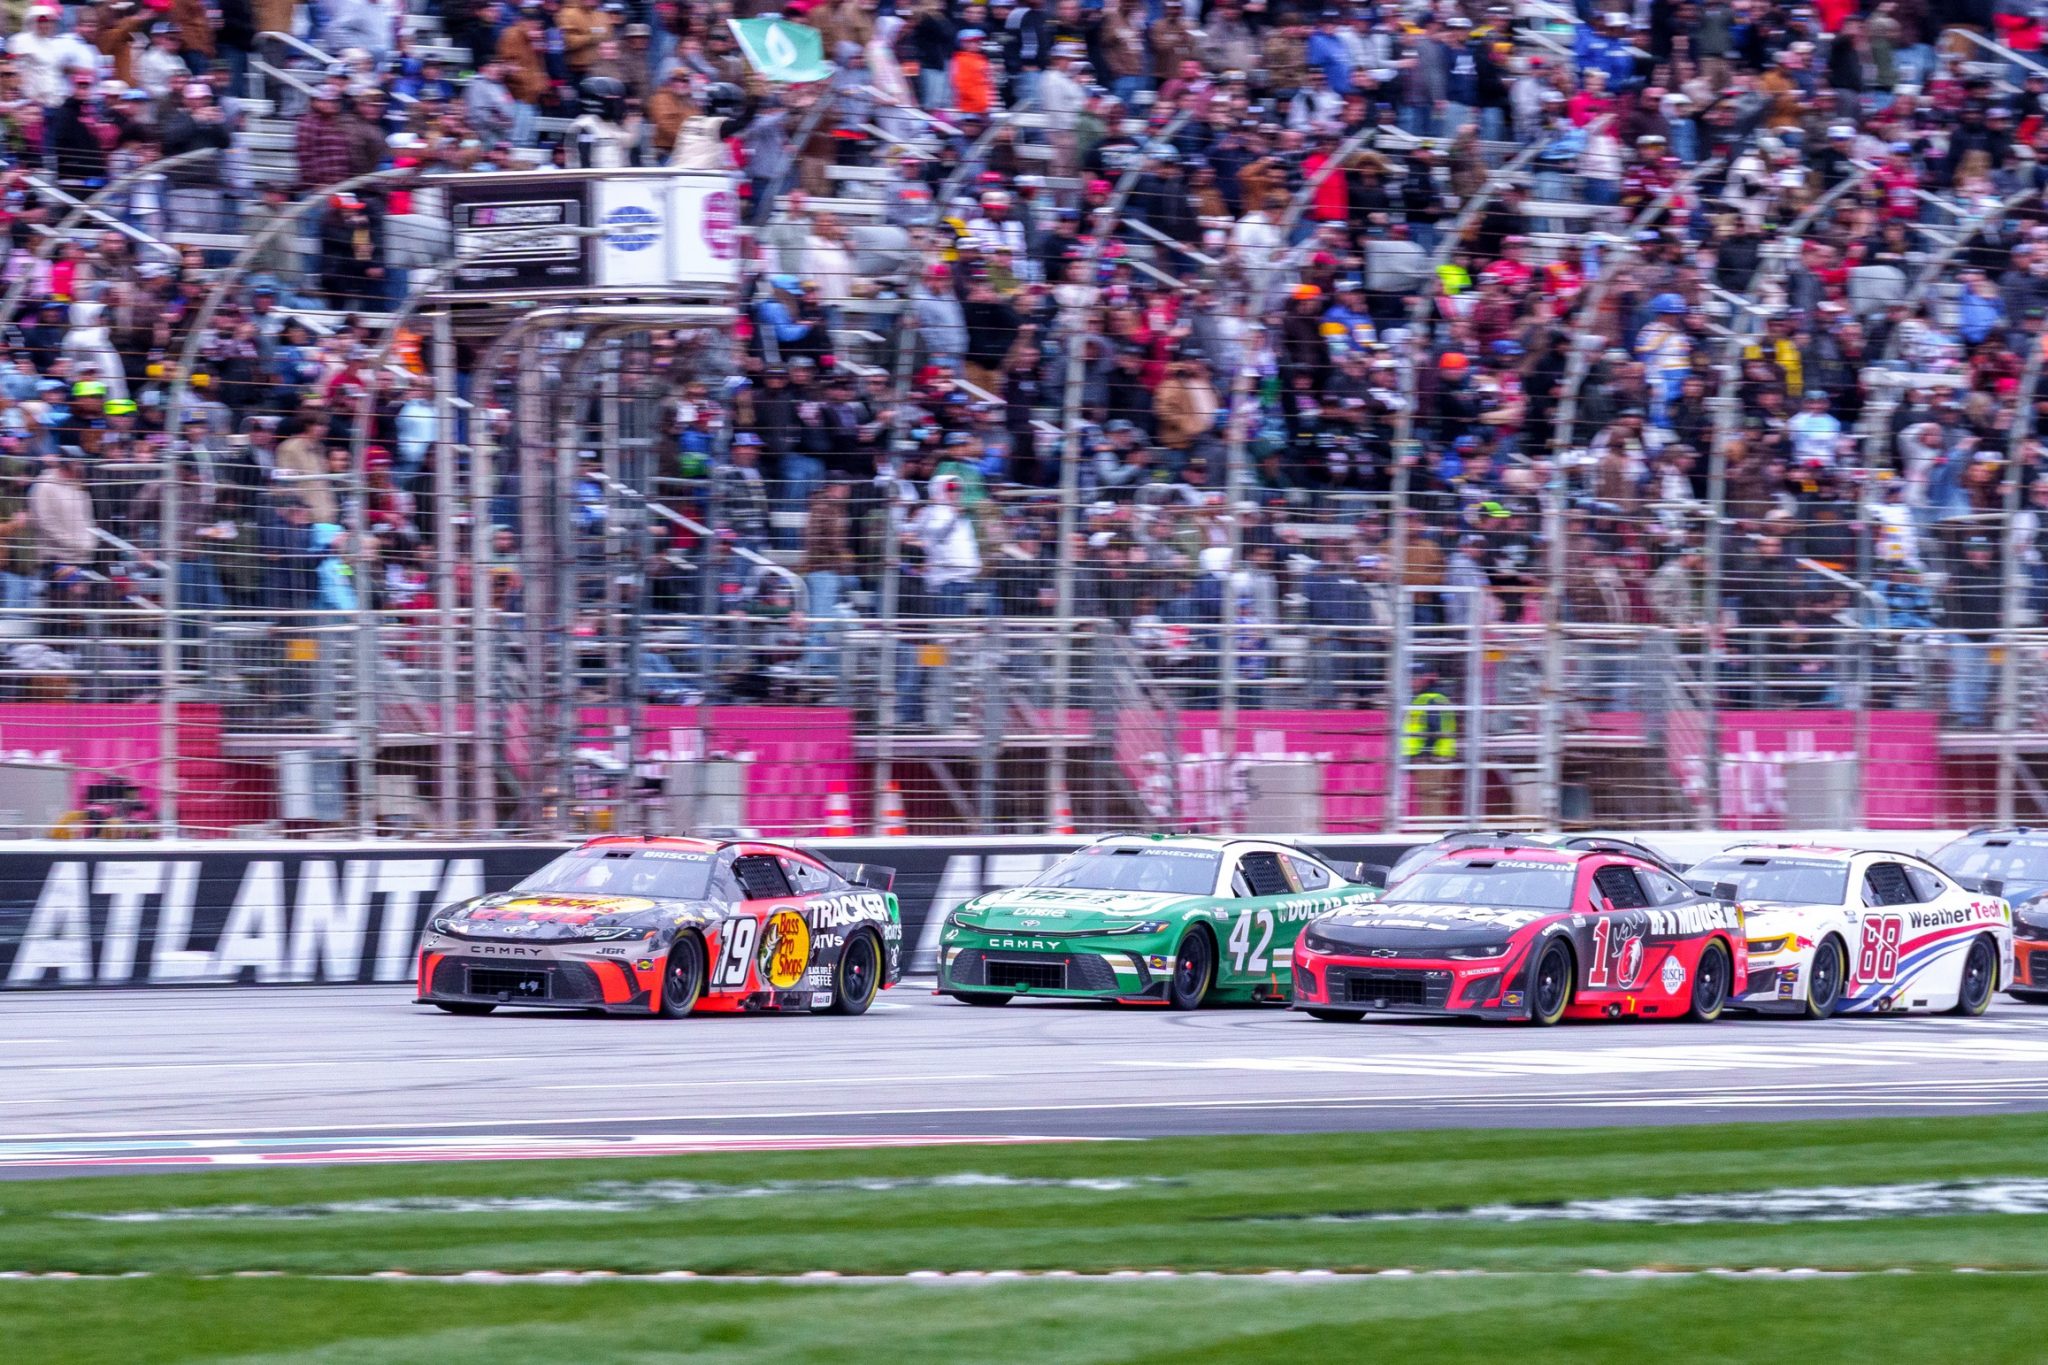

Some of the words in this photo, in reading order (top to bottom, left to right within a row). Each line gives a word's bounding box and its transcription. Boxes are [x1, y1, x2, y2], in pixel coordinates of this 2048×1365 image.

[643, 851, 709, 862] BRISCOE
[1144, 849, 1216, 859] NEMECHEK
[1497, 861, 1575, 872] CHASTAIN
[804, 893, 889, 929] TRACKER
[1908, 900, 2001, 929] WeatherTech
[779, 913, 800, 935] Bass
[780, 936, 795, 955] Pro
[812, 933, 845, 949] ATVs
[989, 938, 1061, 950] CAMRY
[1229, 909, 1275, 974] 42
[470, 945, 543, 957] CAMRY
[596, 947, 626, 956] JGR
[711, 917, 758, 986] 19
[1588, 916, 1611, 987] 1
[1857, 914, 1903, 985] 88
[777, 953, 803, 981] Shops
[1304, 959, 1312, 969] 1
[808, 975, 833, 986] COFFEE
[1661, 968, 1686, 981] BUSCH
